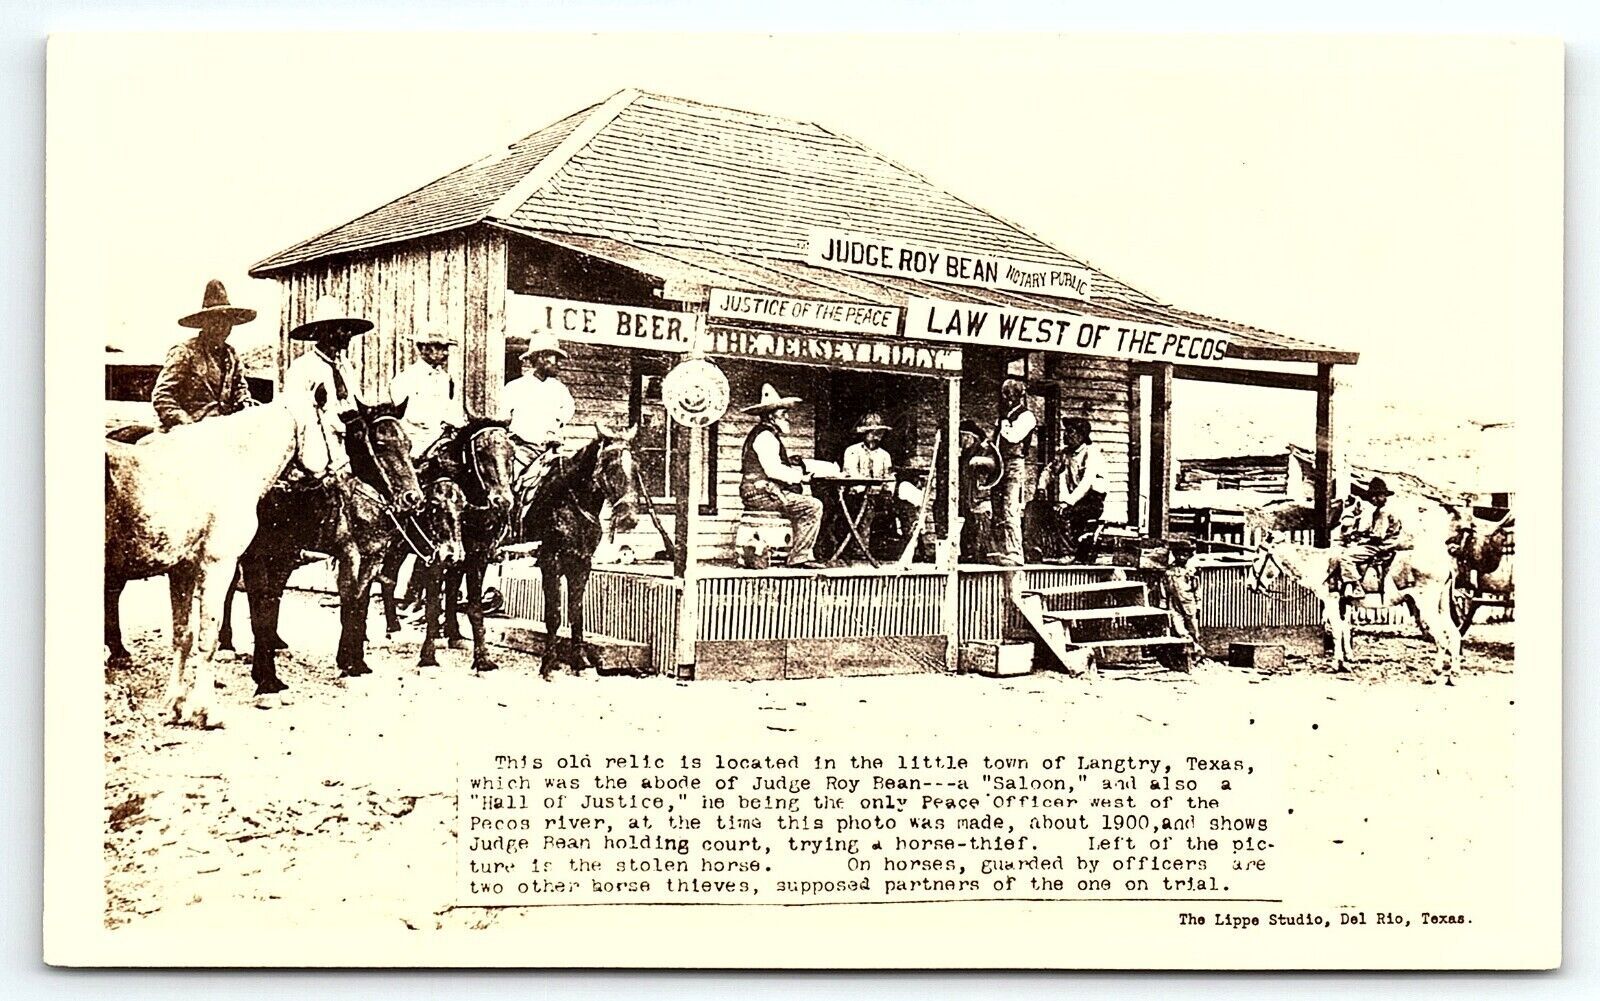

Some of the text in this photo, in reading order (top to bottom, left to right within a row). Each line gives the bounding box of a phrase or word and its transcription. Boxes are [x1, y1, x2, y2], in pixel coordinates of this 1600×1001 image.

[822, 239, 998, 283] JUDGE ROY BEAN
[1006, 264, 1088, 296] NOTARY PUBLIC
[545, 306, 688, 343] ICE BEER.
[720, 294, 892, 328] JUSTICE OF THE PEACE
[712, 331, 758, 354] THE
[927, 306, 1228, 361] LAW WEST OF THE PECOS
